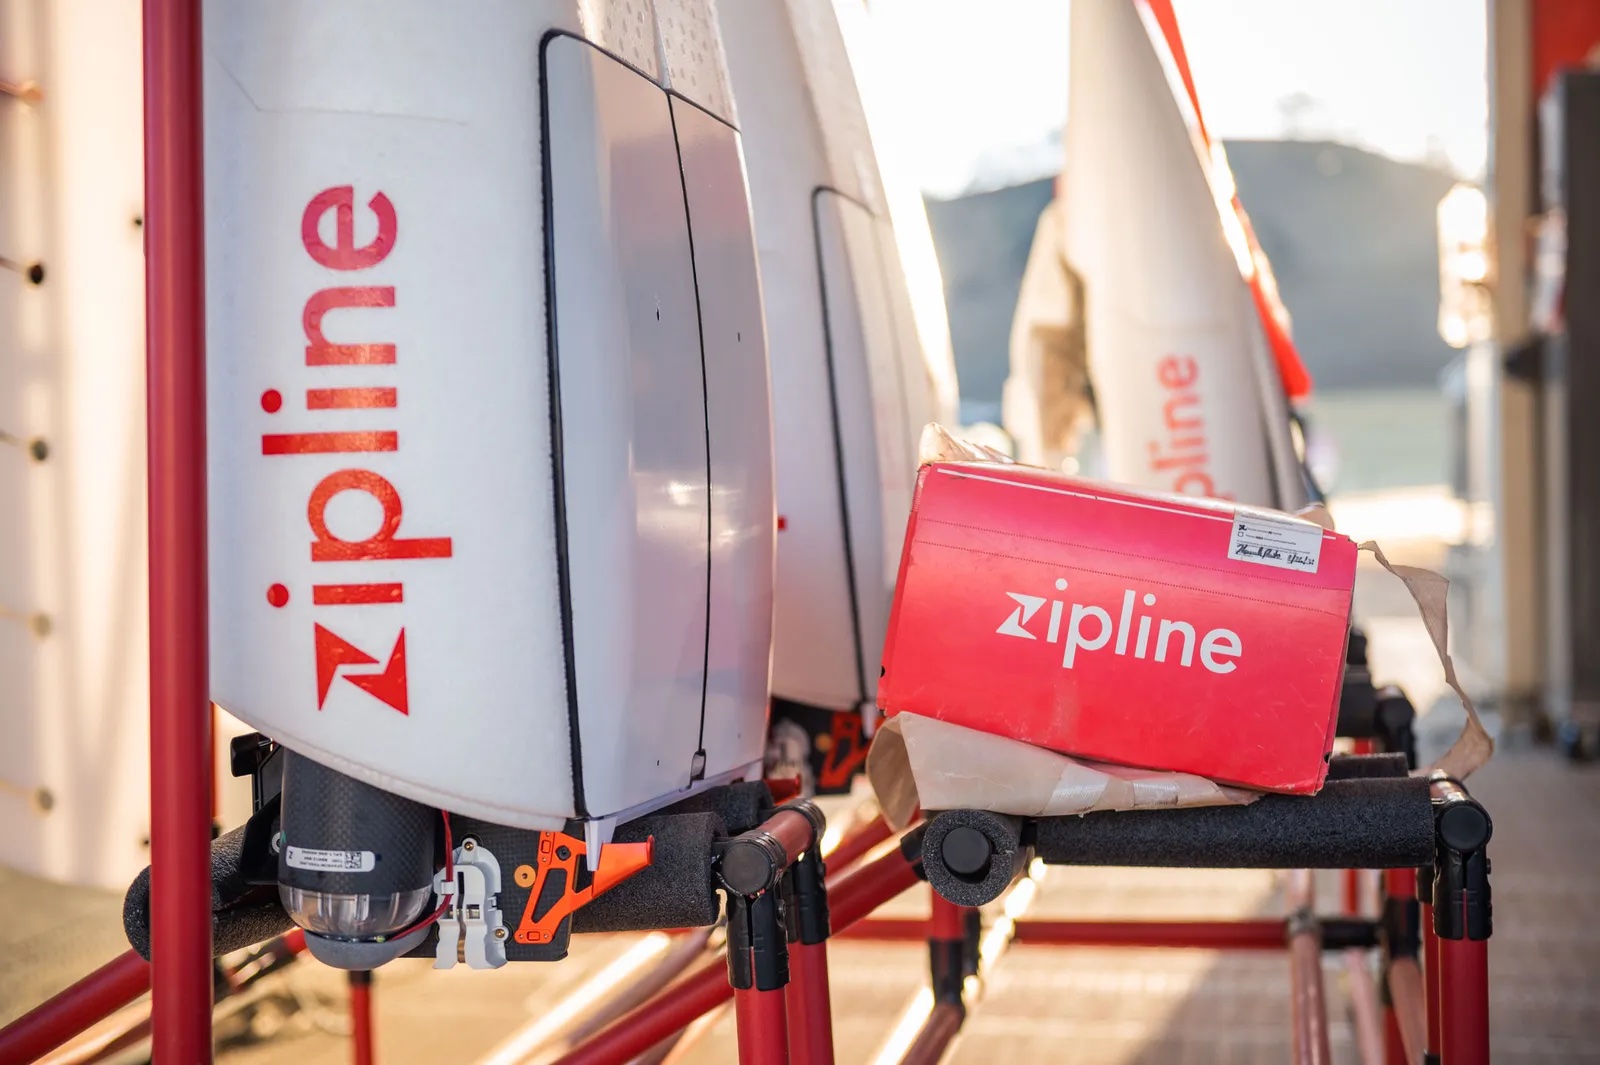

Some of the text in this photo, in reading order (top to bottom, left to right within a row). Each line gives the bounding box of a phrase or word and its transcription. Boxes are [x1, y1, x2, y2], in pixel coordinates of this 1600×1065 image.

[261, 185, 452, 716] zipline
[1147, 354, 1236, 501] pline
[996, 578, 1242, 674] zipline
